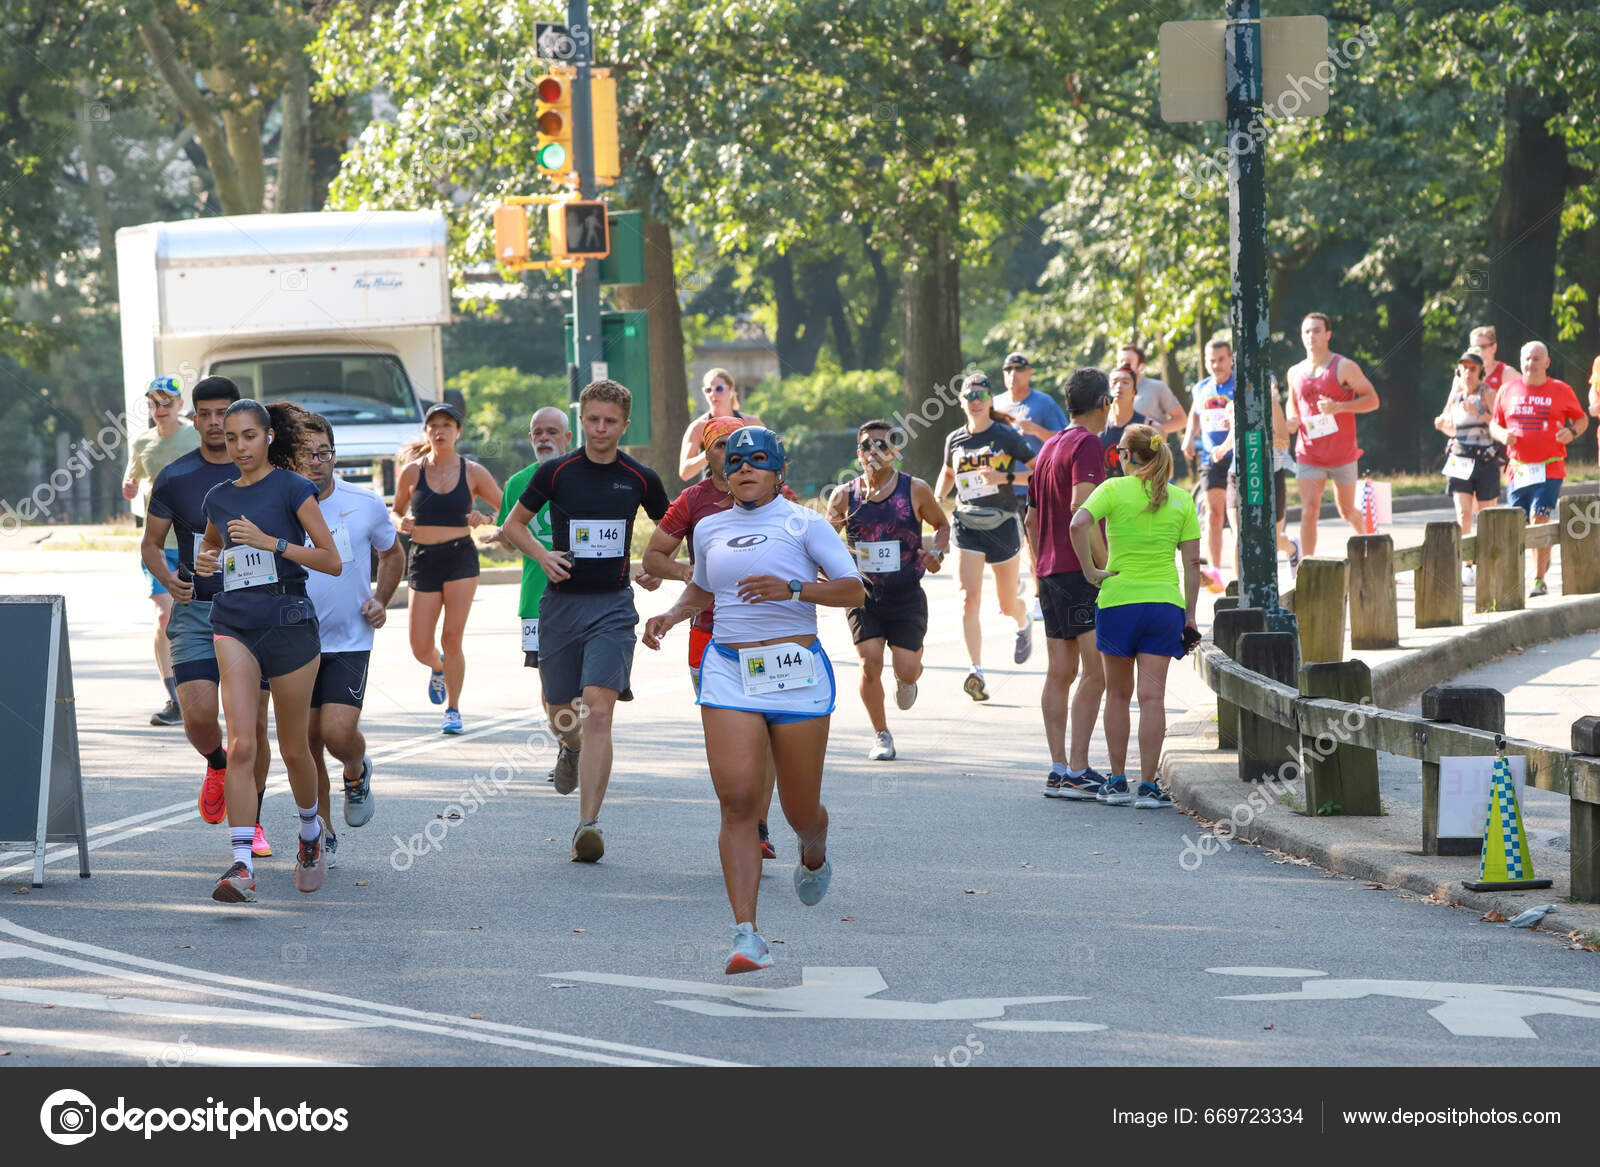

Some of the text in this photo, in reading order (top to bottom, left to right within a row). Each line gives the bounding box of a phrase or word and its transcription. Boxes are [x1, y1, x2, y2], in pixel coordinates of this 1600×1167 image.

[1528, 396, 1552, 406] POLO
[736, 430, 755, 447] A
[1248, 433, 1260, 503] E7207
[599, 528, 618, 540] 146
[245, 552, 261, 567] 111
[878, 547, 891, 558] 82
[776, 651, 802, 669] 144
